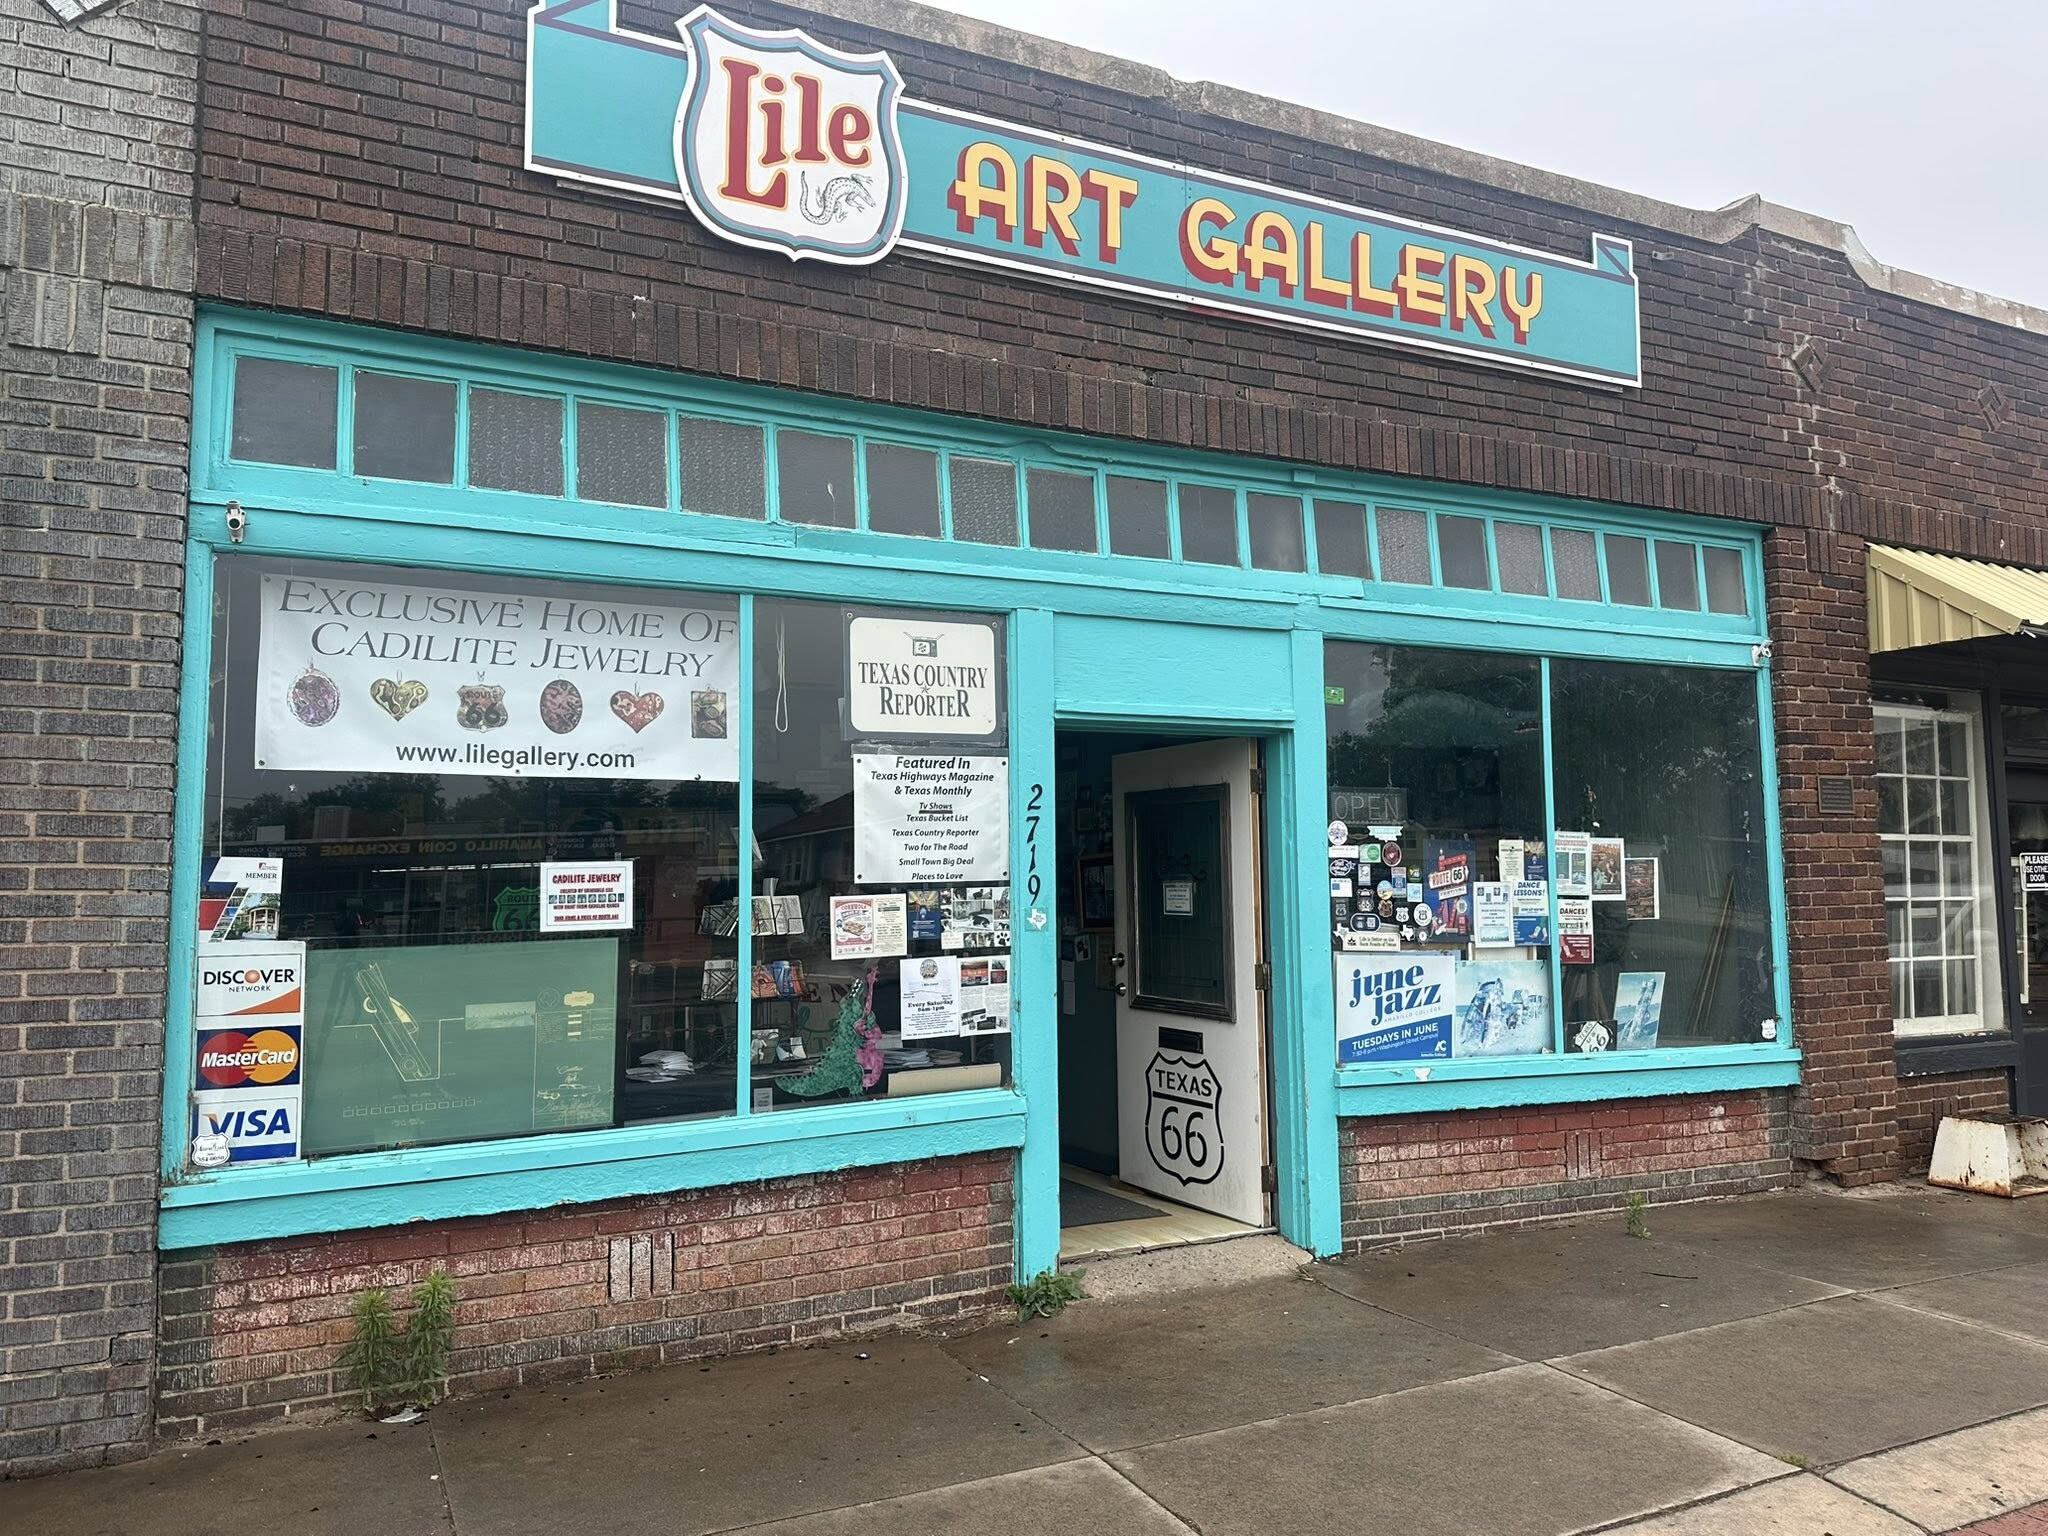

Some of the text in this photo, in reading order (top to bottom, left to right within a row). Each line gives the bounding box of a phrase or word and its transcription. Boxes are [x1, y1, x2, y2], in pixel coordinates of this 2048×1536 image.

[719, 57, 873, 211] Lile
[947, 141, 1543, 345] ART GALLERY
[278, 580, 737, 644] EXCLUSIVE HOME OF
[311, 621, 714, 677] CADILITE JEWELRY
[858, 662, 988, 689] TEXAS COUNTRY
[880, 686, 971, 718] REPORTER
[396, 743, 635, 769] www.lilegallery.com
[895, 755, 971, 770] Featured In
[871, 771, 995, 783] Texas Highways Magazine
[894, 785, 973, 798] & Texas Monthly
[929, 802, 953, 810] Shows
[1333, 795, 1400, 821] OPEN
[906, 814, 969, 823] Texas Bucket List
[892, 828, 980, 838] Texas Country Reporter
[903, 843, 920, 851] Two
[920, 843, 932, 851] for
[948, 843, 968, 851] Road
[1025, 783, 1043, 907] 2719
[899, 857, 974, 867] Small Town Big Deal
[2024, 855, 2048, 864] PLEASE
[552, 873, 622, 885] CADILITE JEWELRY
[911, 872, 935, 881] Places
[946, 872, 964, 881] Love
[1432, 869, 1463, 887] ROUTE 66
[1517, 881, 1541, 889] DANCE
[2029, 874, 2046, 882] DOOR
[203, 968, 295, 985] DISCOVER
[228, 985, 271, 993] NETWORK
[1350, 965, 1424, 1008] june
[927, 1000, 954, 1008] Saturday
[1371, 984, 1442, 1026] jazz
[1351, 1022, 1439, 1051] TUESDAYS IN JUNE
[1435, 1040, 1447, 1052] AC
[201, 1047, 296, 1068] MasterCard
[1155, 1069, 1212, 1096] TEXAS
[202, 1108, 291, 1138] VISA
[1161, 1106, 1207, 1168] 66
